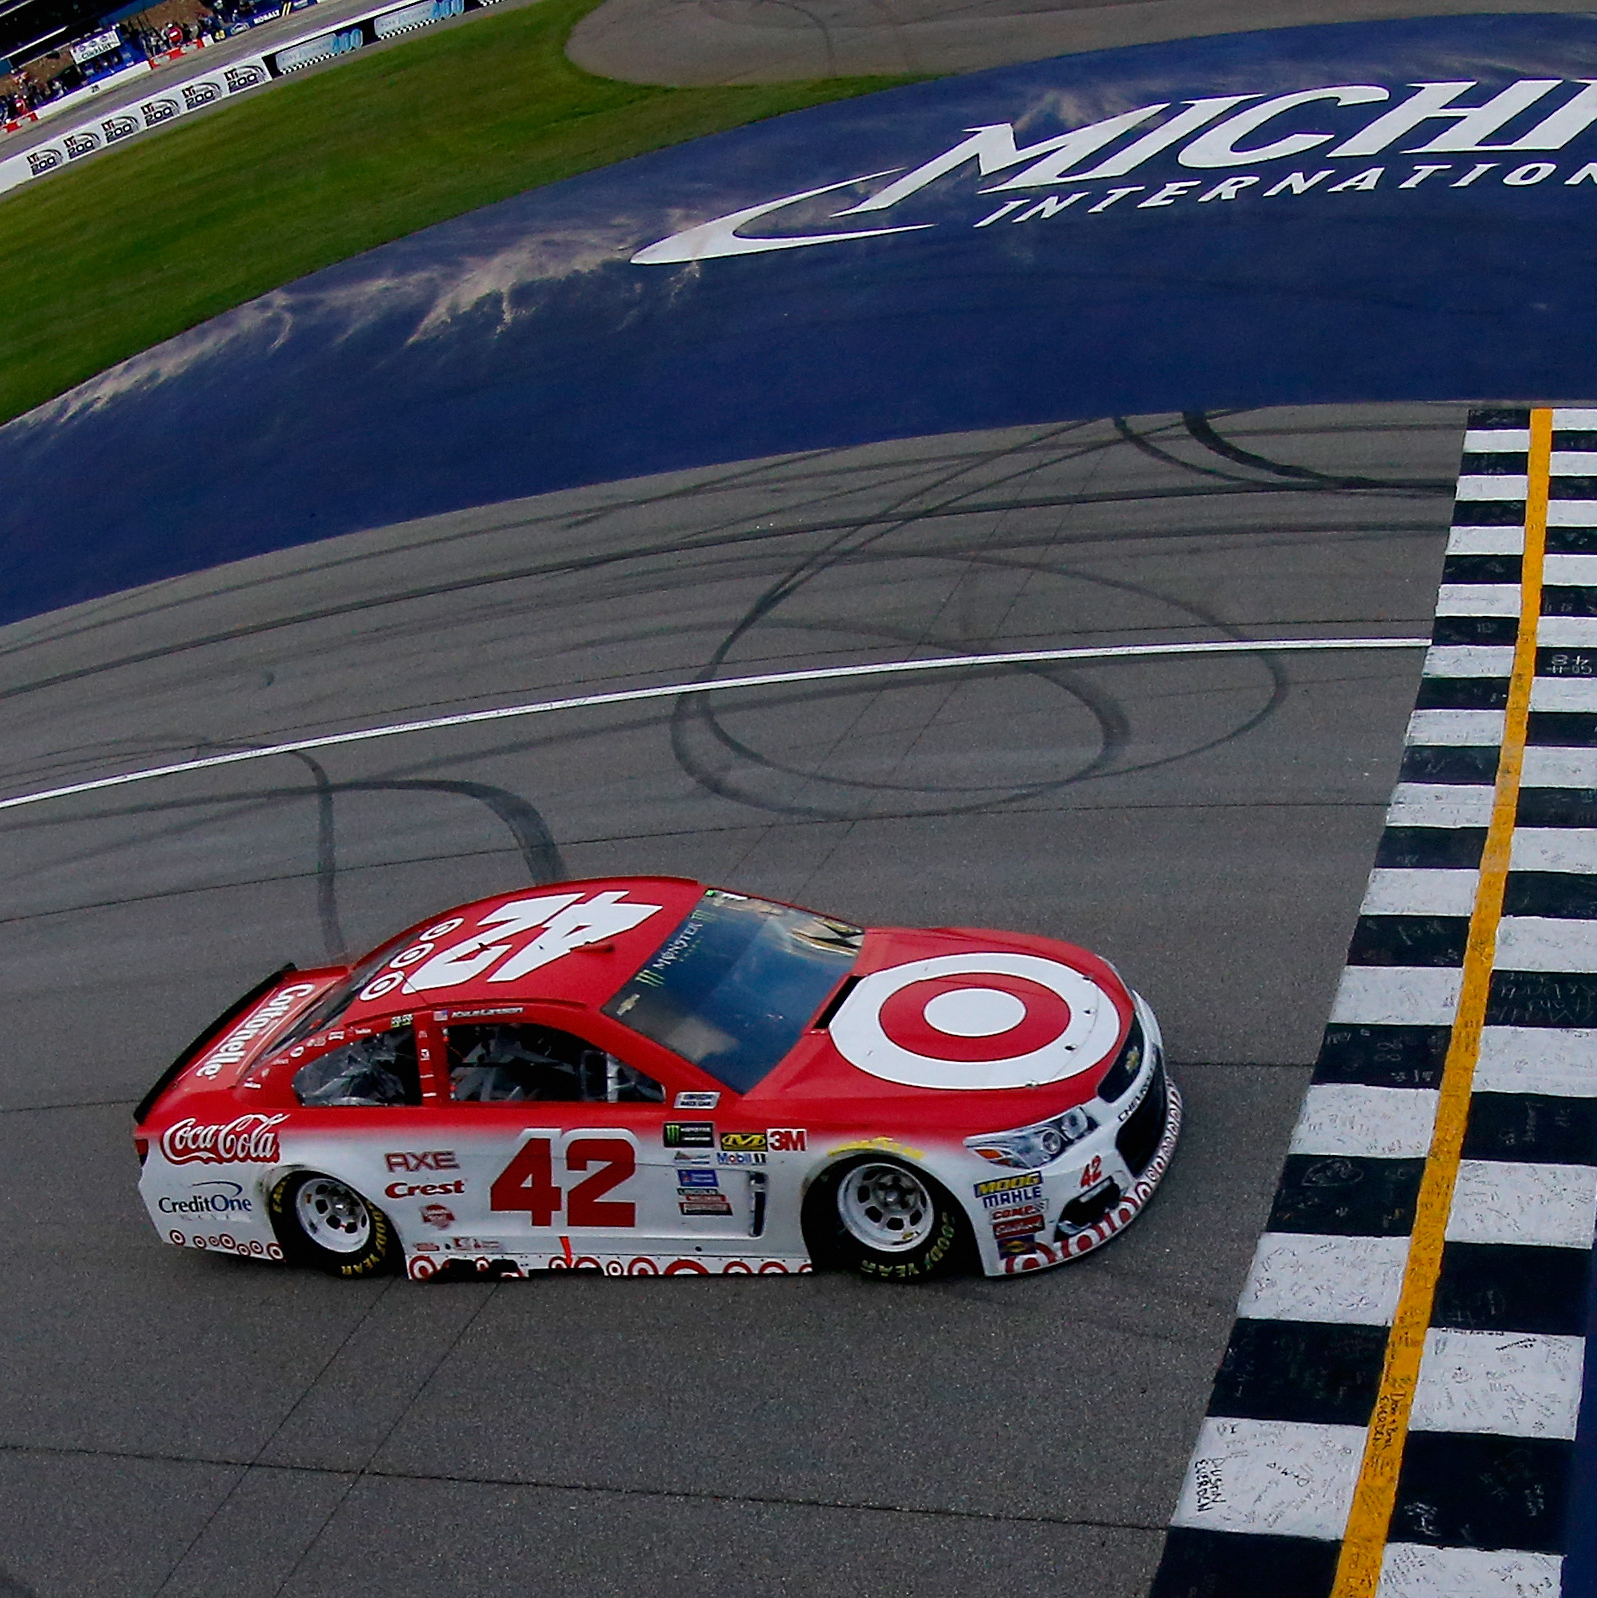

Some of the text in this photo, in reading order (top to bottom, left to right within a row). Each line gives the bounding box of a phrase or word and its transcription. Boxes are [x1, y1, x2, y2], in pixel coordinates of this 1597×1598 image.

[402, 890, 663, 994] 42
[196, 983, 314, 1077] Cottonelle
[163, 1113, 290, 1161] Coca-Cola
[770, 1131, 806, 1151] 3M
[384, 1150, 460, 1173] AXE
[717, 1153, 752, 1165] Mobil
[490, 1138, 636, 1228] 42
[1079, 1155, 1102, 1189] 42
[385, 1179, 466, 1199] Crest
[978, 1174, 1039, 1195] MOOG
[983, 1186, 1041, 1208] MAHLE
